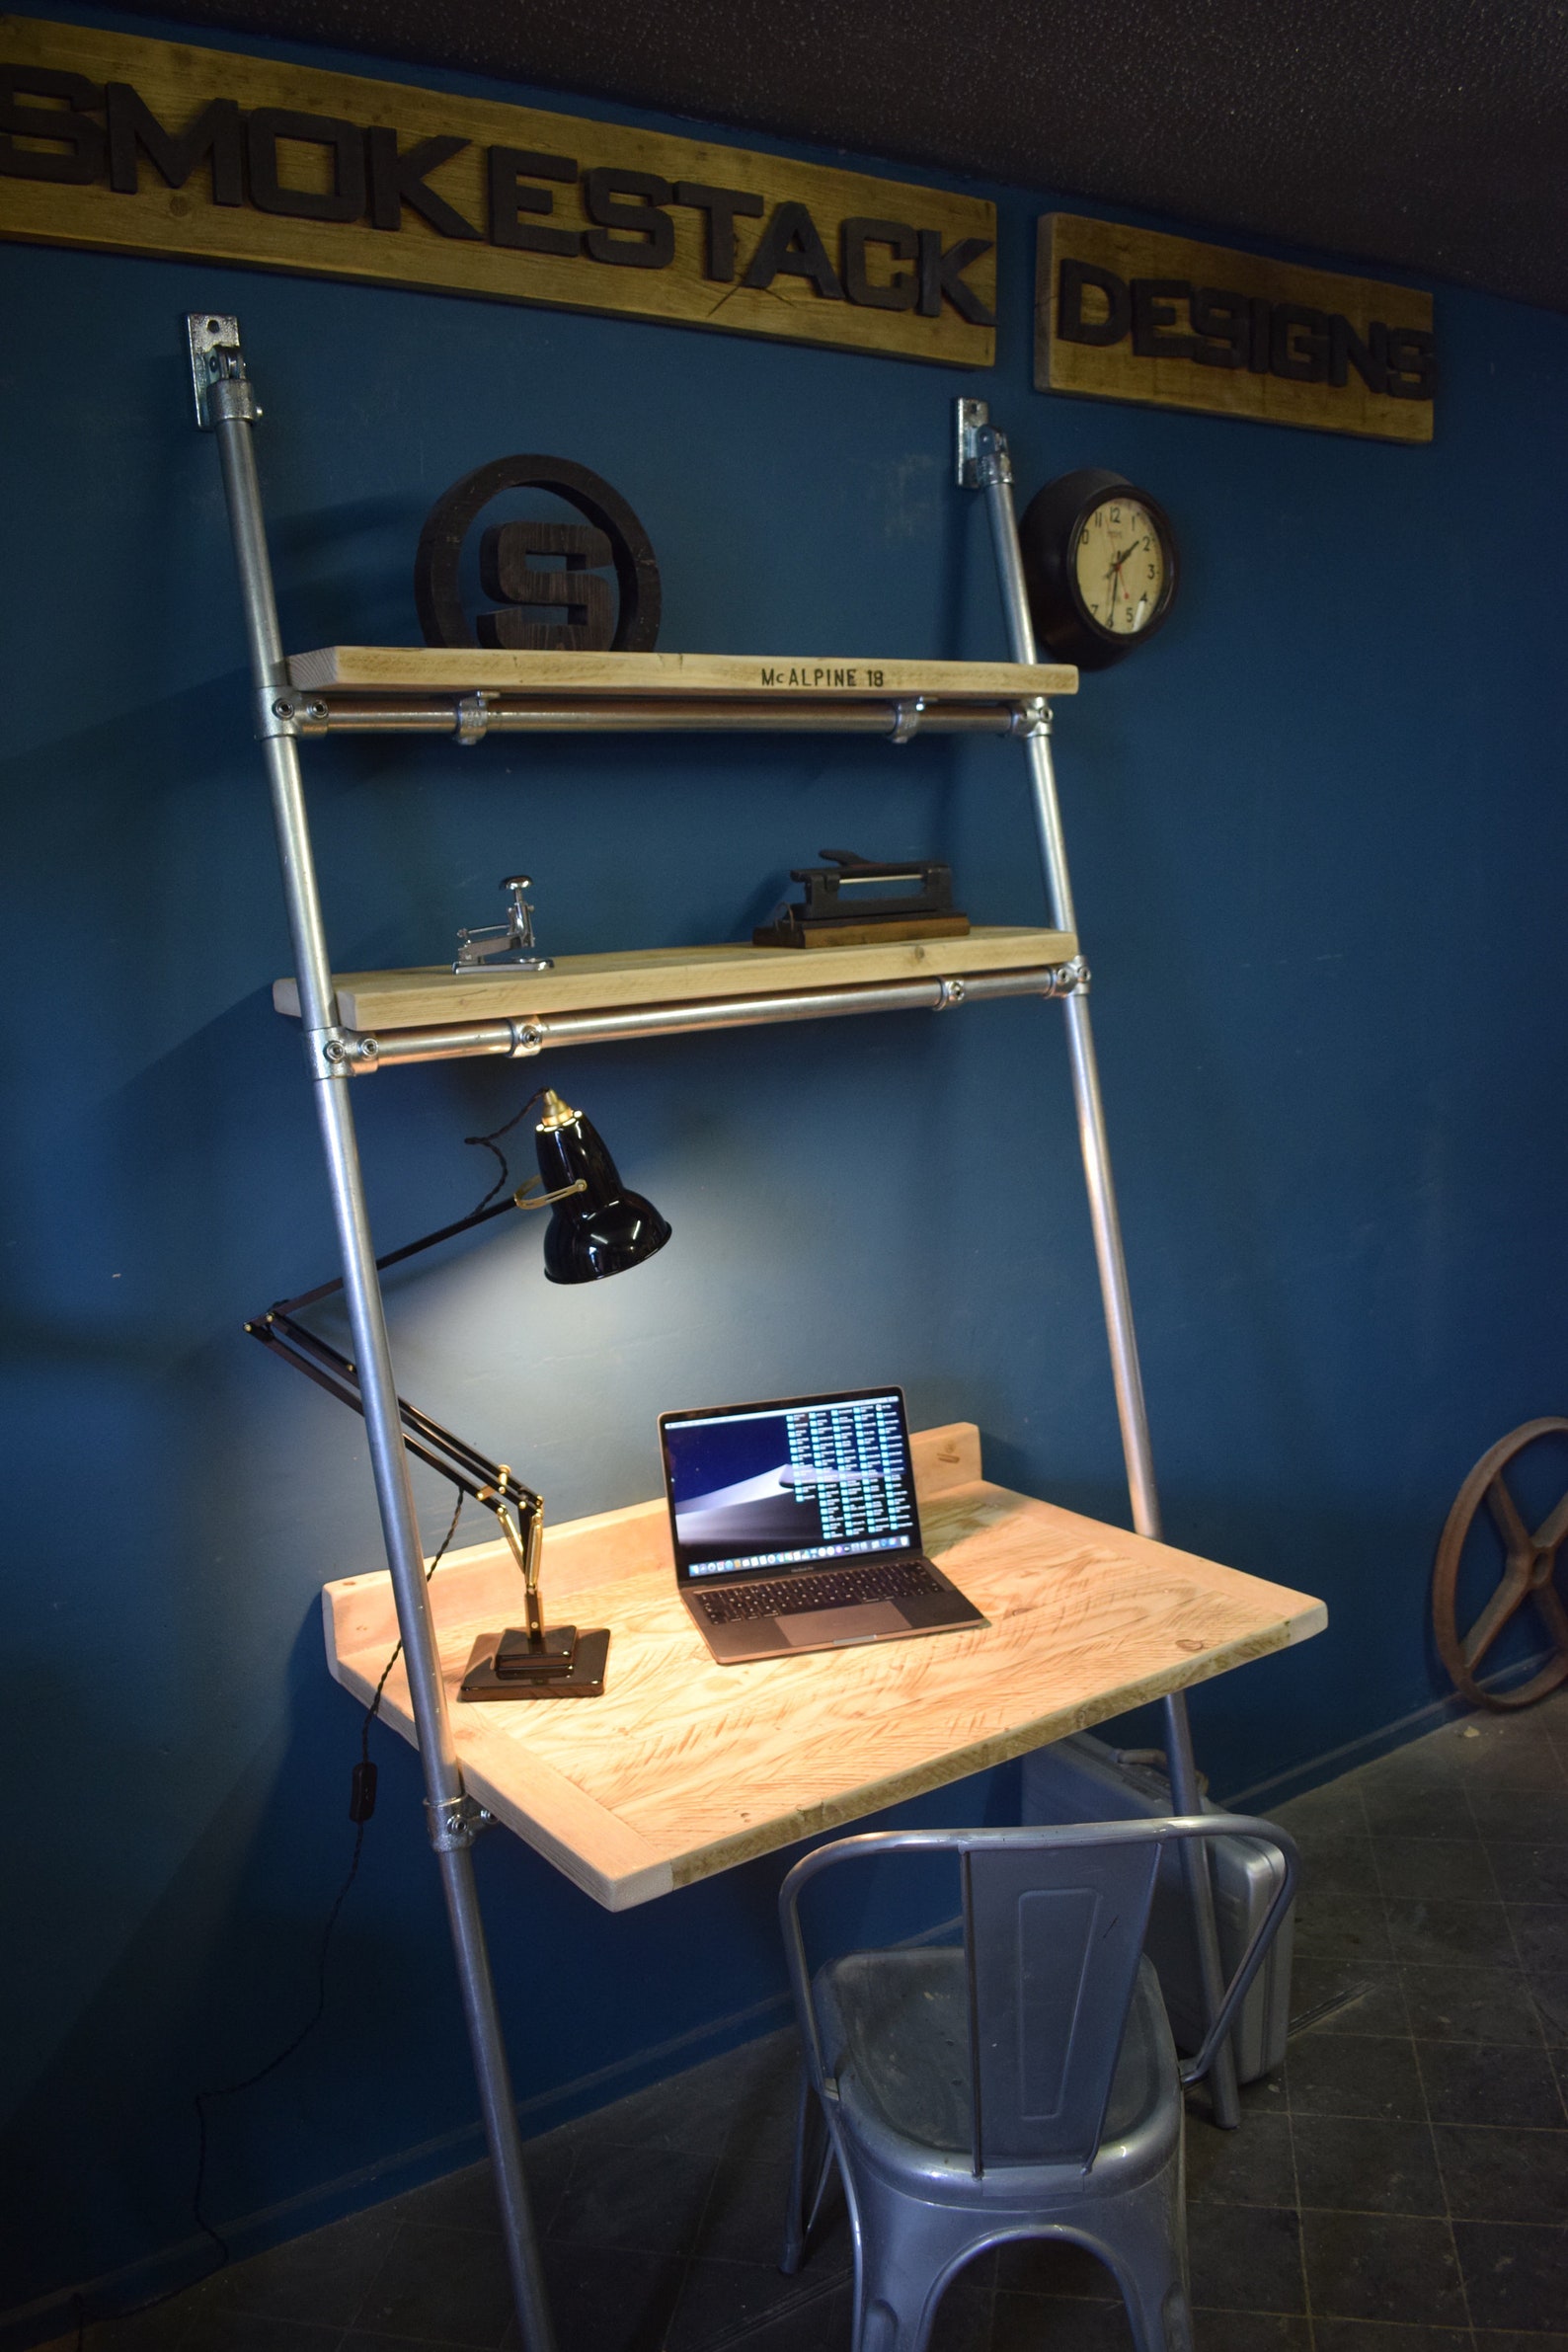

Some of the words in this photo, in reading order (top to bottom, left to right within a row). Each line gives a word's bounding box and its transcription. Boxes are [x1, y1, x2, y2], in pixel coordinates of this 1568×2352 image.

[0, 63, 997, 327] SMOKESTACK
[1058, 258, 1440, 401] DESIGNS
[1094, 511, 1102, 527] 11
[1110, 507, 1121, 523] 12
[1142, 536, 1150, 552] 2
[1147, 564, 1155, 581] 3
[1126, 607, 1134, 623] 5
[761, 667, 857, 687] McALPINE
[867, 668, 884, 687] 18
